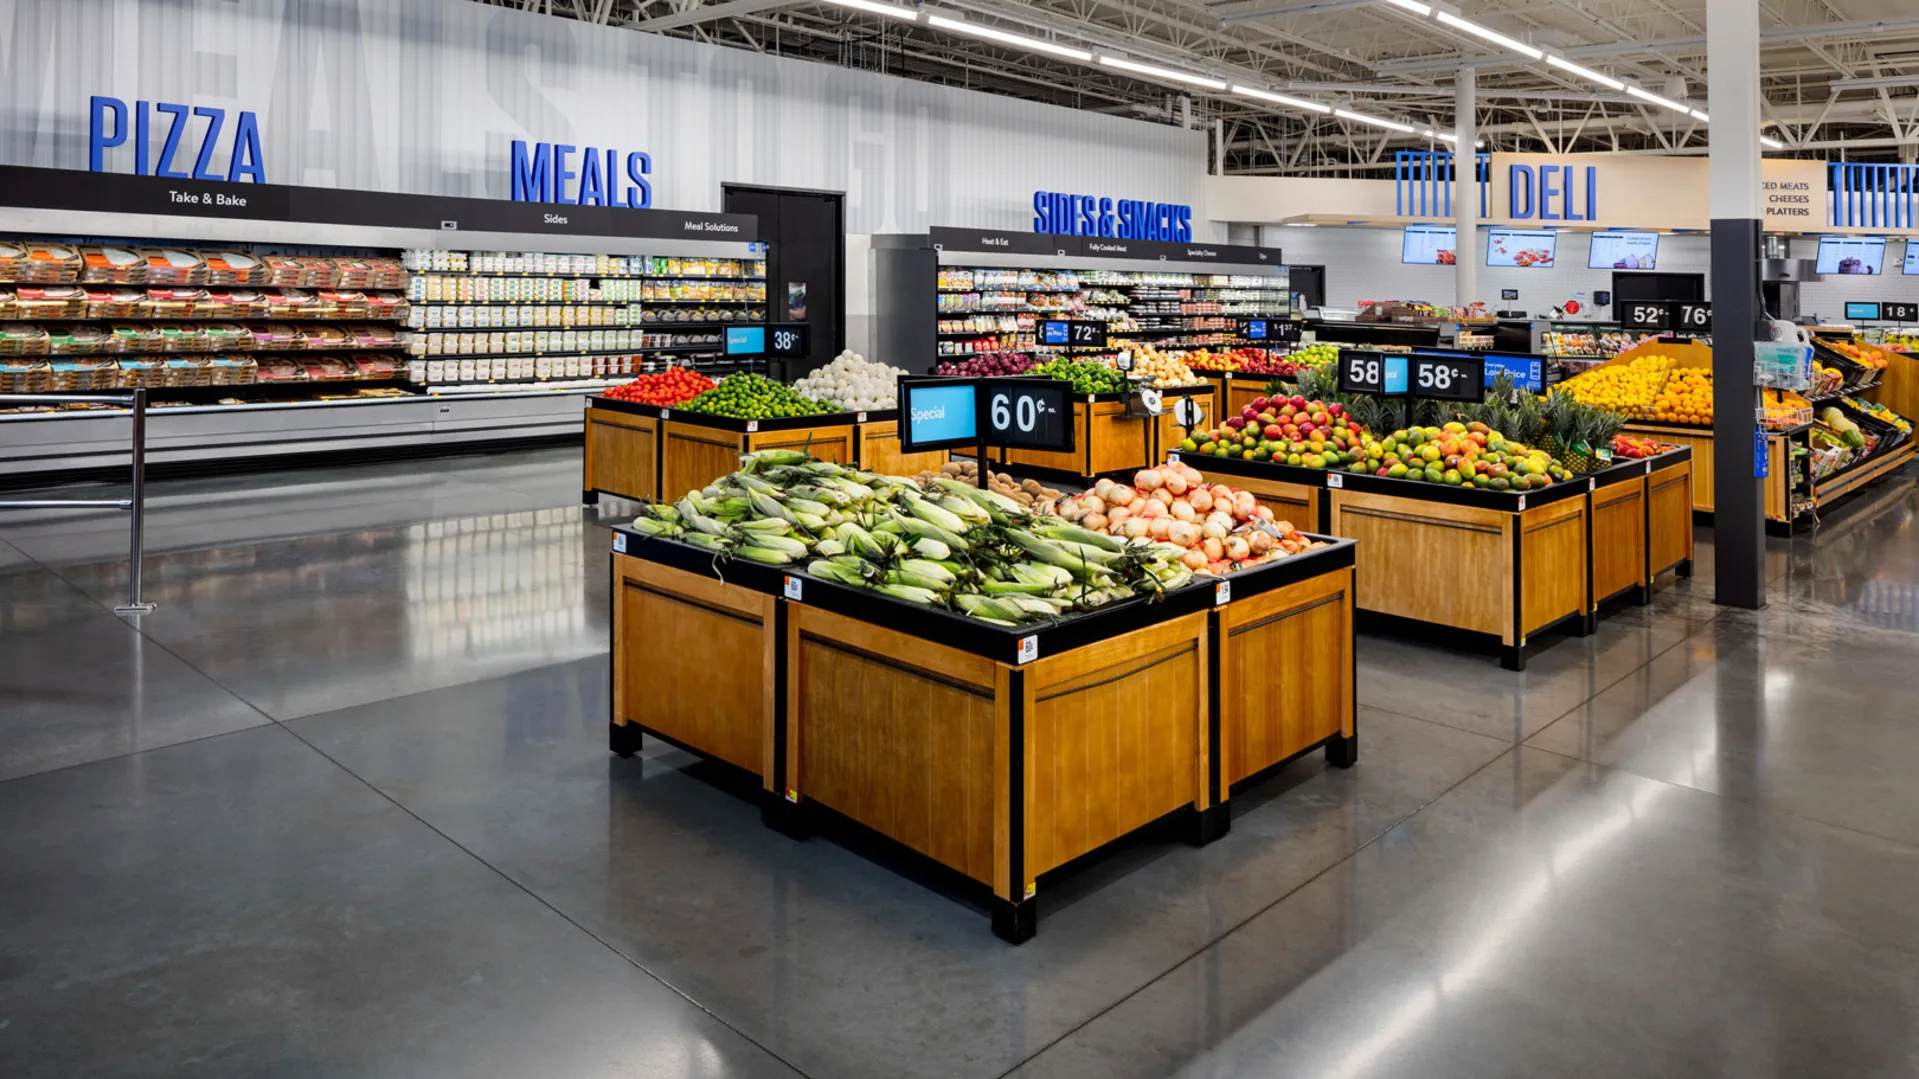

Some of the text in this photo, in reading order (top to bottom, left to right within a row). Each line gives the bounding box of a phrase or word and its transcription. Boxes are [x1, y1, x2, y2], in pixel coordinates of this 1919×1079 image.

[89, 95, 266, 184] PIZZA
[511, 140, 653, 209] MEALS
[1509, 163, 1597, 221] DELI
[1762, 181, 1810, 191] ED MEATS
[168, 190, 247, 207] Take & Bake
[1768, 194, 1810, 204] CHEESES
[1766, 207, 1810, 216] PLATTERS
[543, 213, 568, 225] Sides
[684, 221, 739, 233] Meal Solutions
[981, 237, 995, 245] Heat
[1000, 237, 1009, 246] Eat
[1089, 243, 1128, 252] Fully Cooked Meat
[1349, 358, 1379, 384] 58
[1417, 363, 1459, 389] 58¢
[1504, 368, 1526, 379] Price
[910, 405, 946, 424] Special
